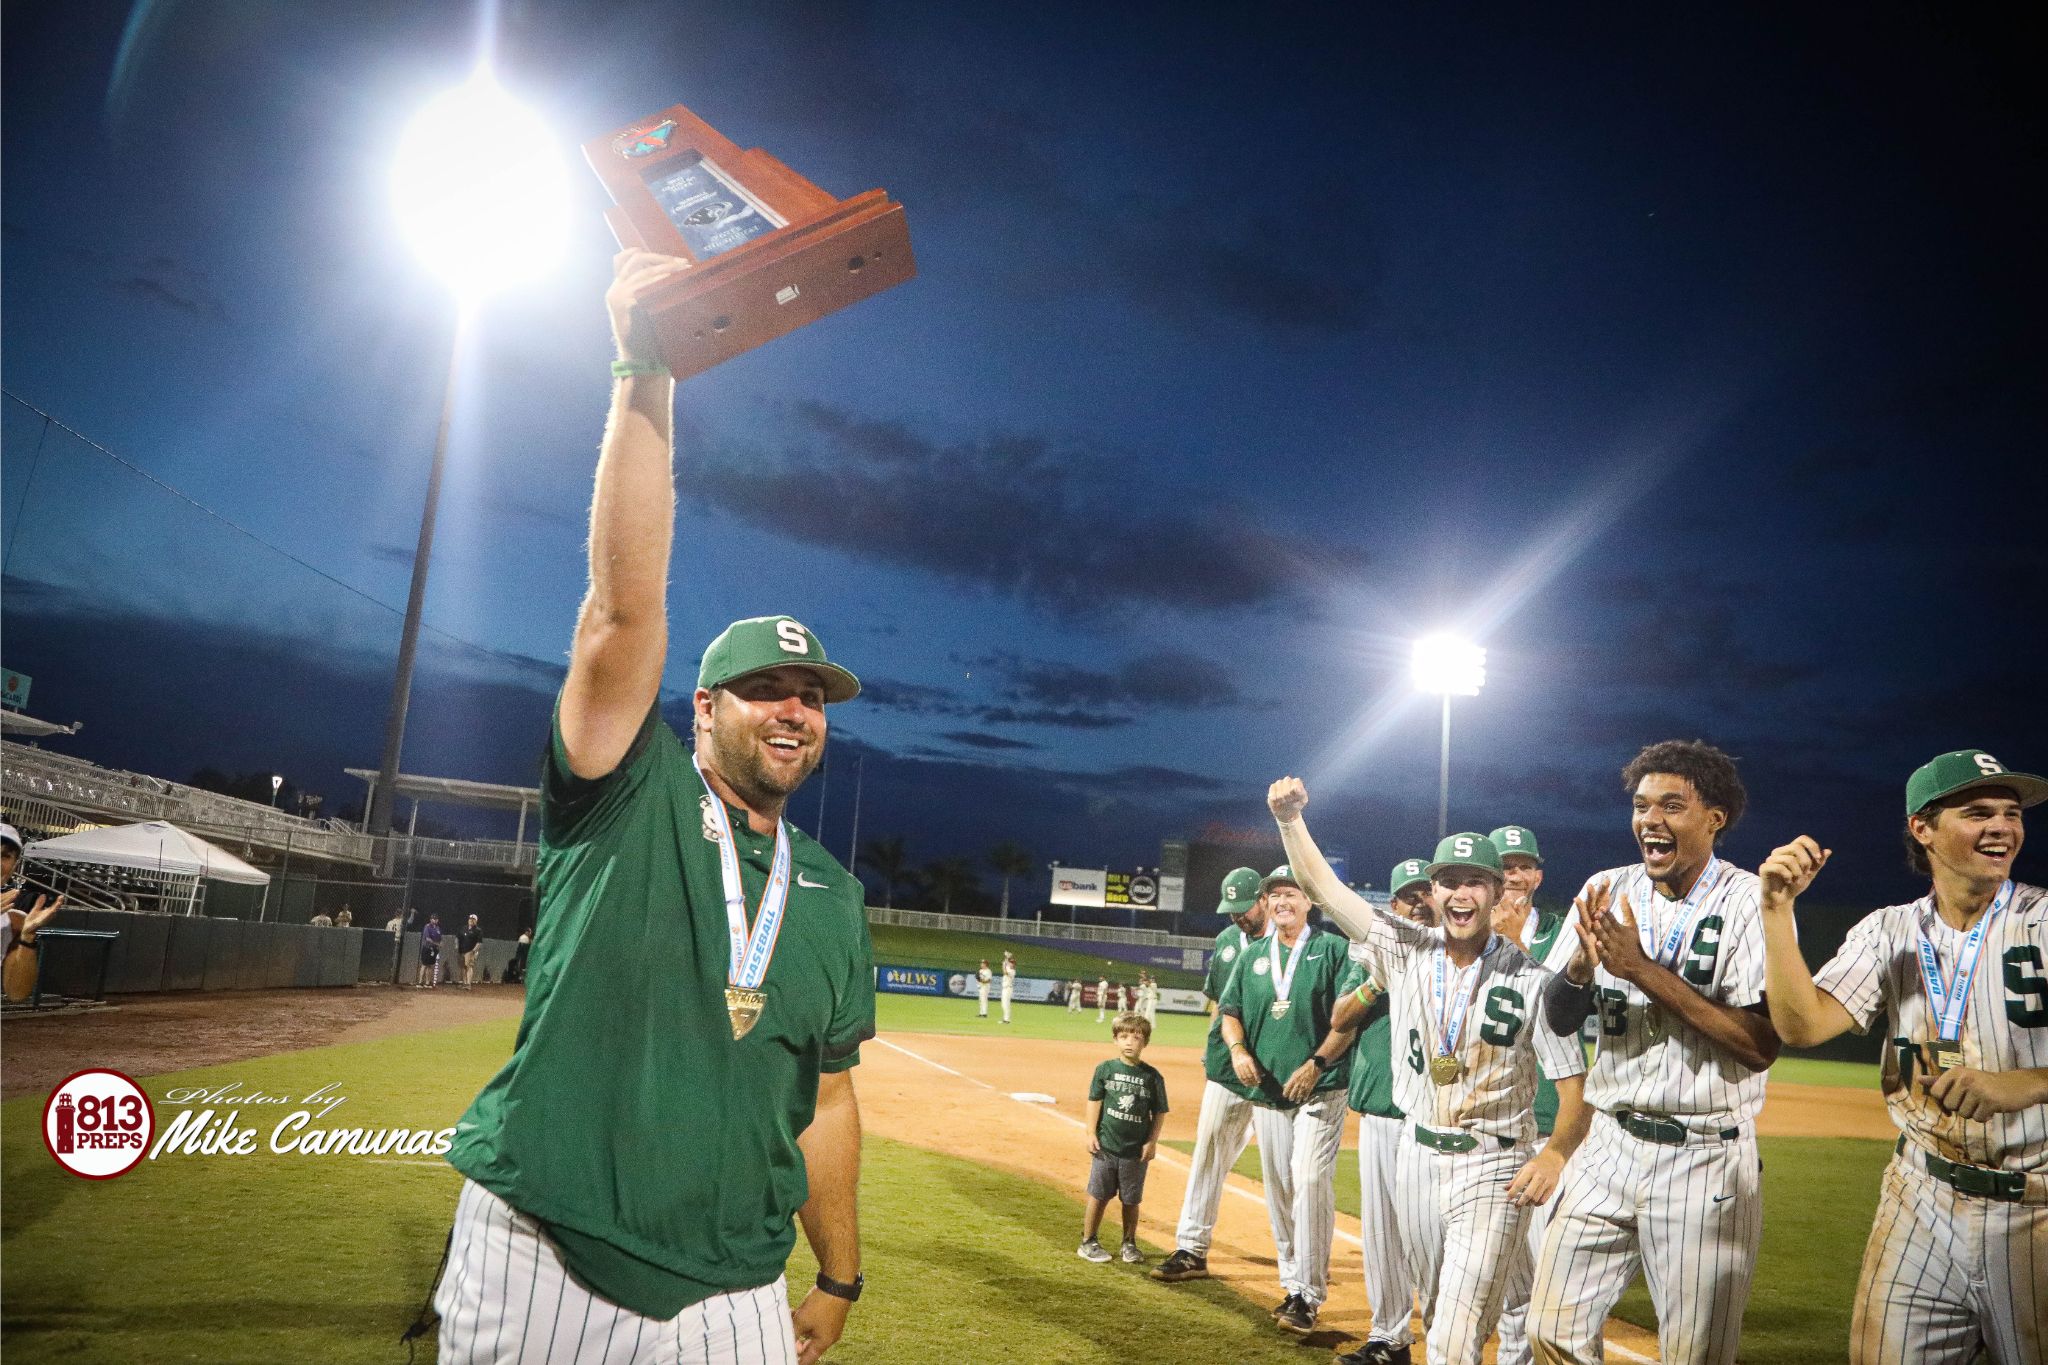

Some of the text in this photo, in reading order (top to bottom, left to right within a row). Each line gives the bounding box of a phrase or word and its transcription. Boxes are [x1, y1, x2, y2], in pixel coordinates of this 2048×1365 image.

[776, 620, 808, 655] S
[1973, 753, 2003, 776] S
[1453, 837, 1474, 858] S
[1505, 829, 1521, 846] S
[1277, 865, 1288, 877] S
[1404, 861, 1420, 876] S
[1226, 886, 1237, 900] S
[745, 909, 776, 987] BASEBALL
[1683, 915, 1724, 986] S
[2002, 944, 2048, 1028] S
[1480, 986, 1525, 1047] S
